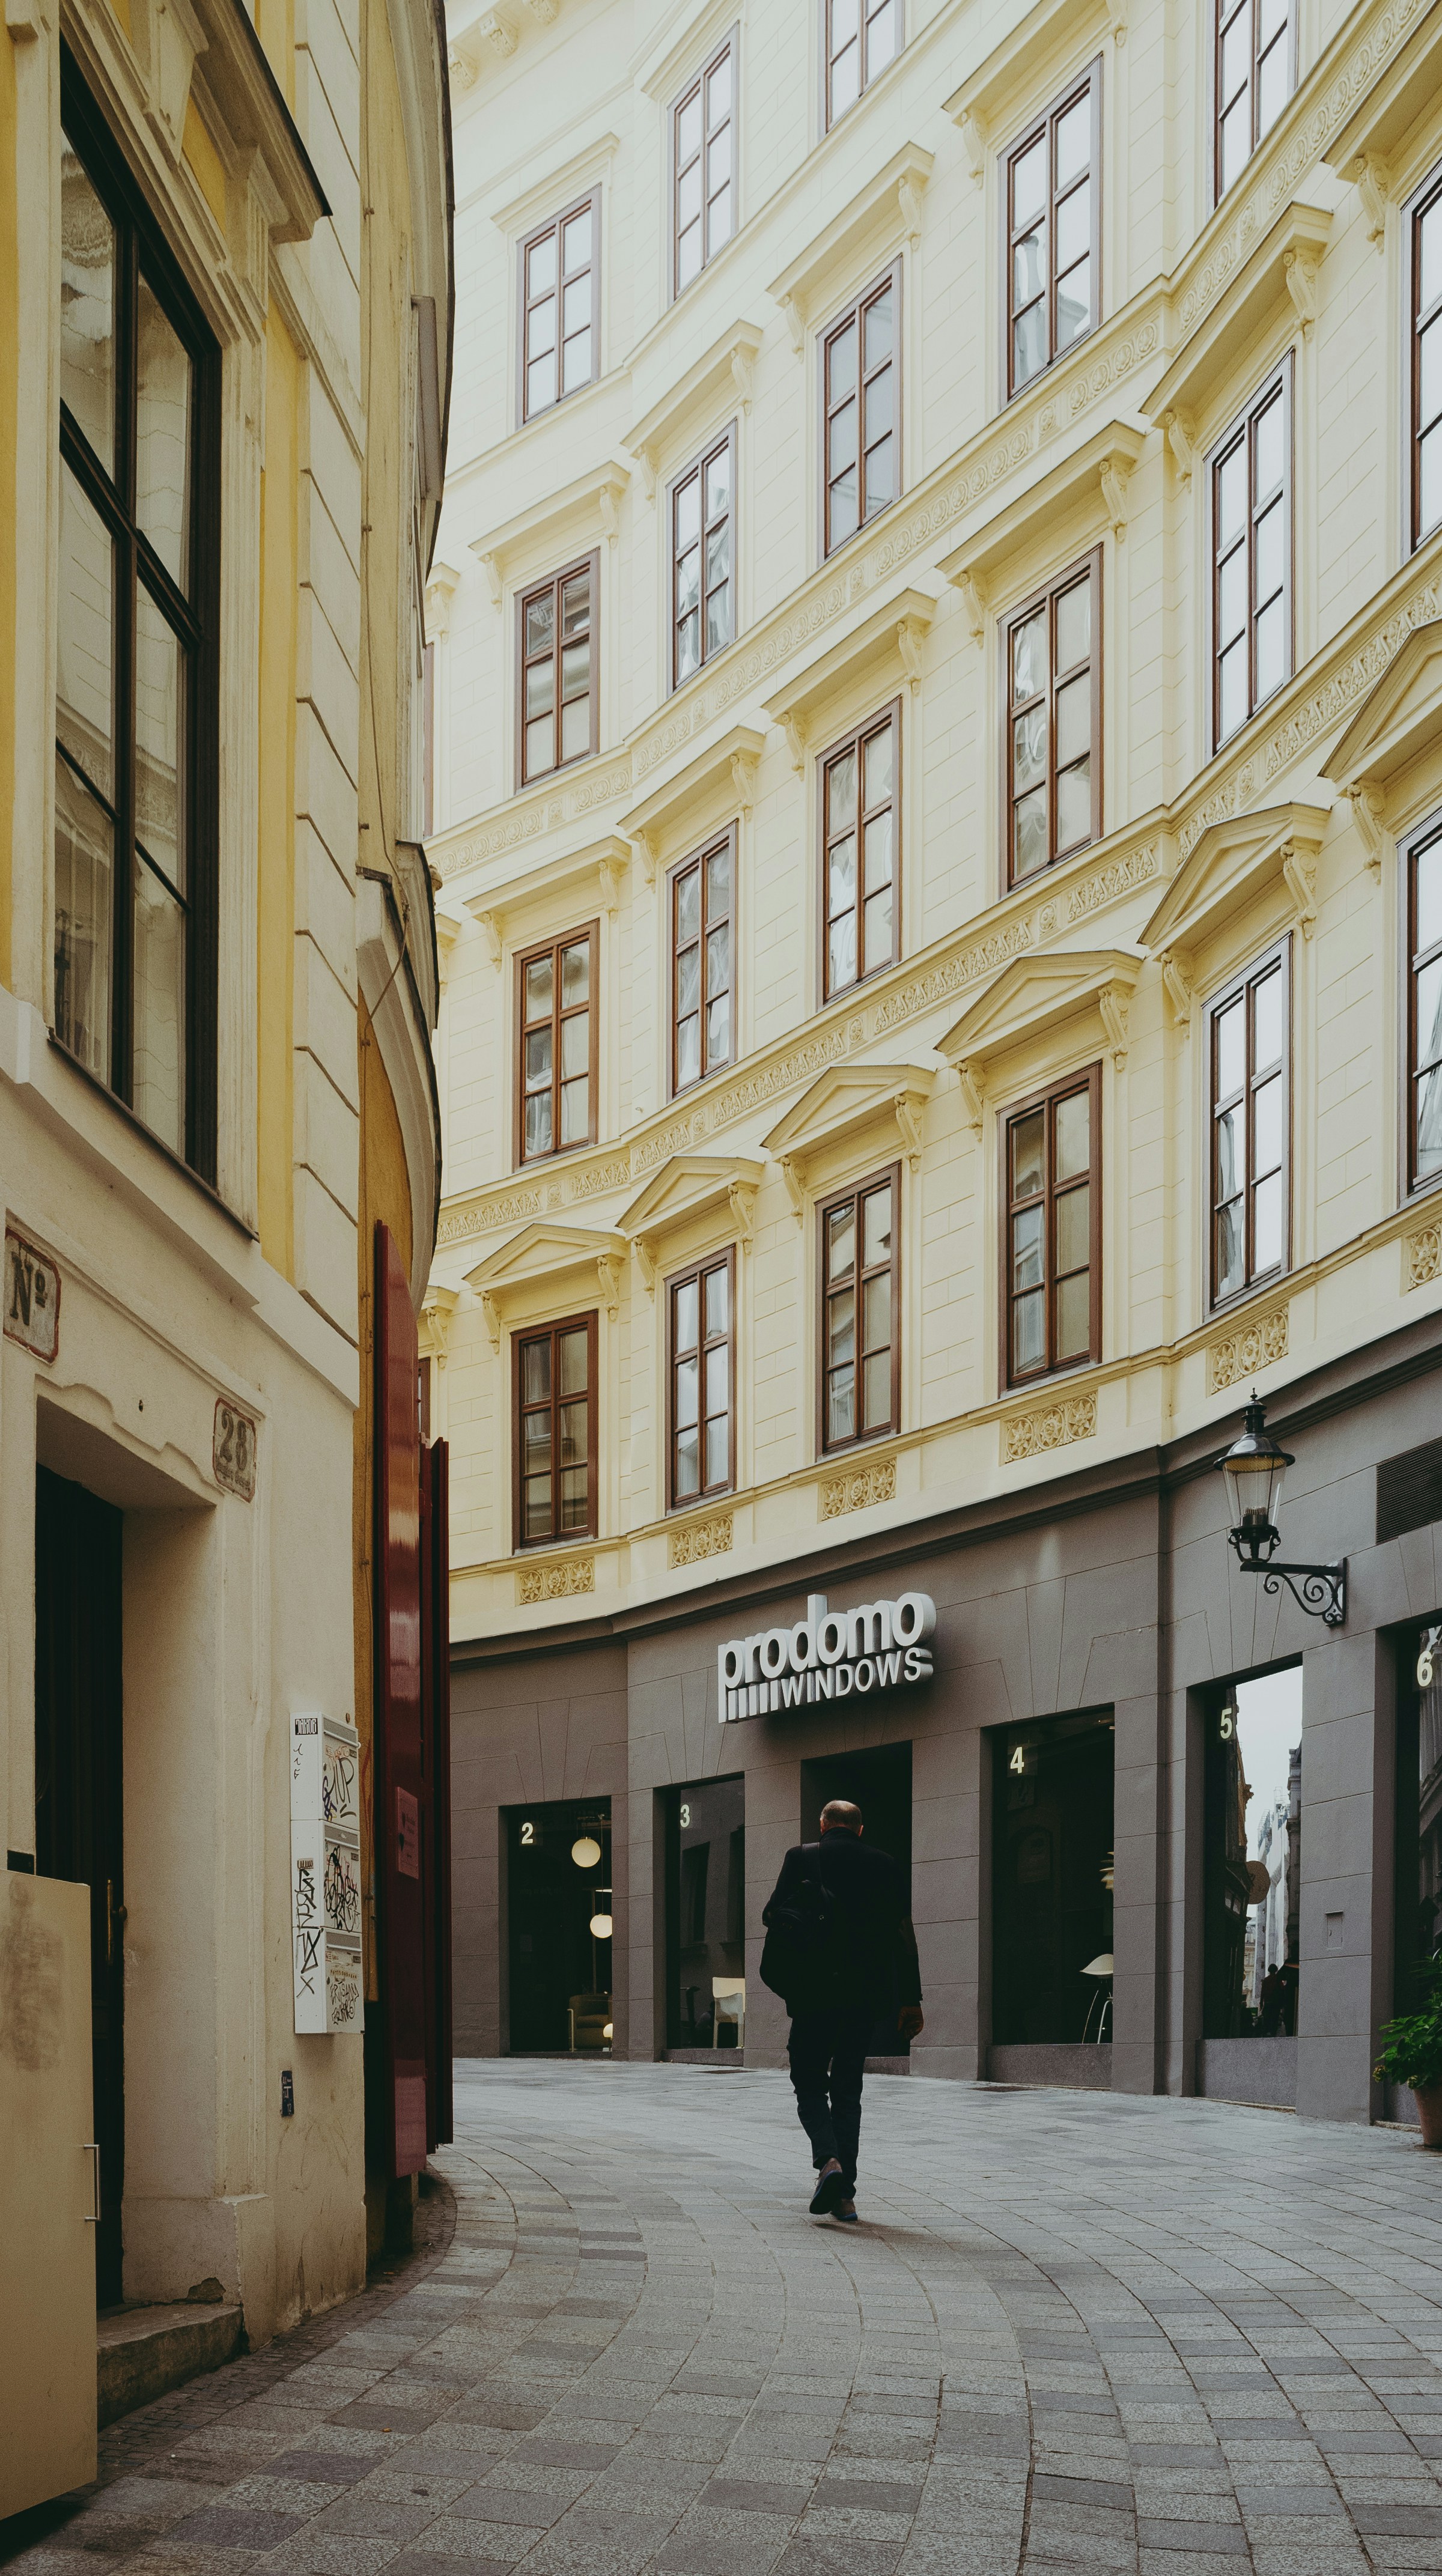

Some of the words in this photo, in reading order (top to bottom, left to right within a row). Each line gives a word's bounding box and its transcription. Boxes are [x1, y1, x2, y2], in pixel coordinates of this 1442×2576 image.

[220, 1408, 248, 1471] 28
[718, 1593, 936, 1723] prodomo
[1417, 1651, 1433, 1687] 6
[782, 1647, 934, 1708] WINDOWS
[1220, 1708, 1232, 1739] 5
[1011, 1747, 1024, 1773] 4
[680, 1804, 690, 1827] 3
[522, 1822, 533, 1844] 2
